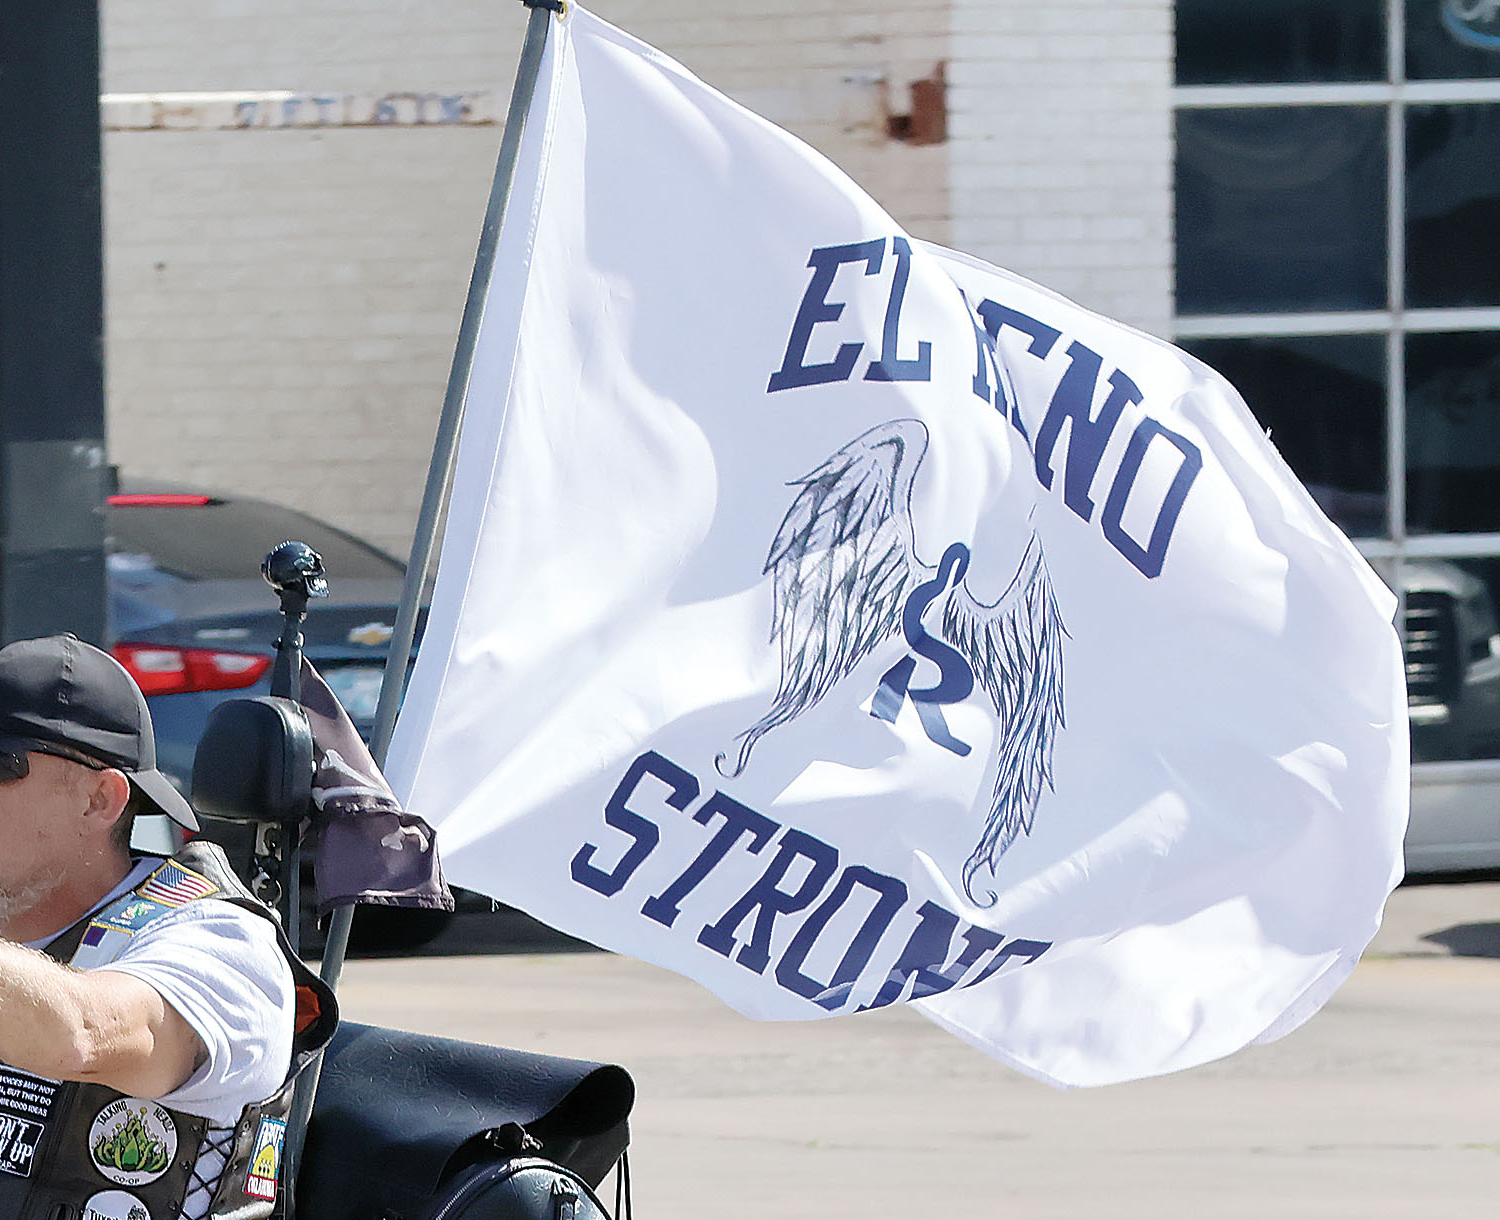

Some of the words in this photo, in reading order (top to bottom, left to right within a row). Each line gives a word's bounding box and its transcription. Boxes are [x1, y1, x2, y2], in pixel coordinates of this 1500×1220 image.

[766, 236, 932, 394] EL
[570, 749, 1054, 1013] STRON
[6, 1087, 21, 1097] BUT
[21, 1091, 40, 1102] THEY
[40, 1096, 52, 1107] DO
[23, 1081, 39, 1092] MAY
[38, 1085, 56, 1096] NOT
[10, 1100, 28, 1112] GOOD
[28, 1103, 48, 1118] IDEAS
[96, 1100, 128, 1126] TALKING
[10, 1141, 34, 1165] UP
[113, 1174, 140, 1185] CO-OP
